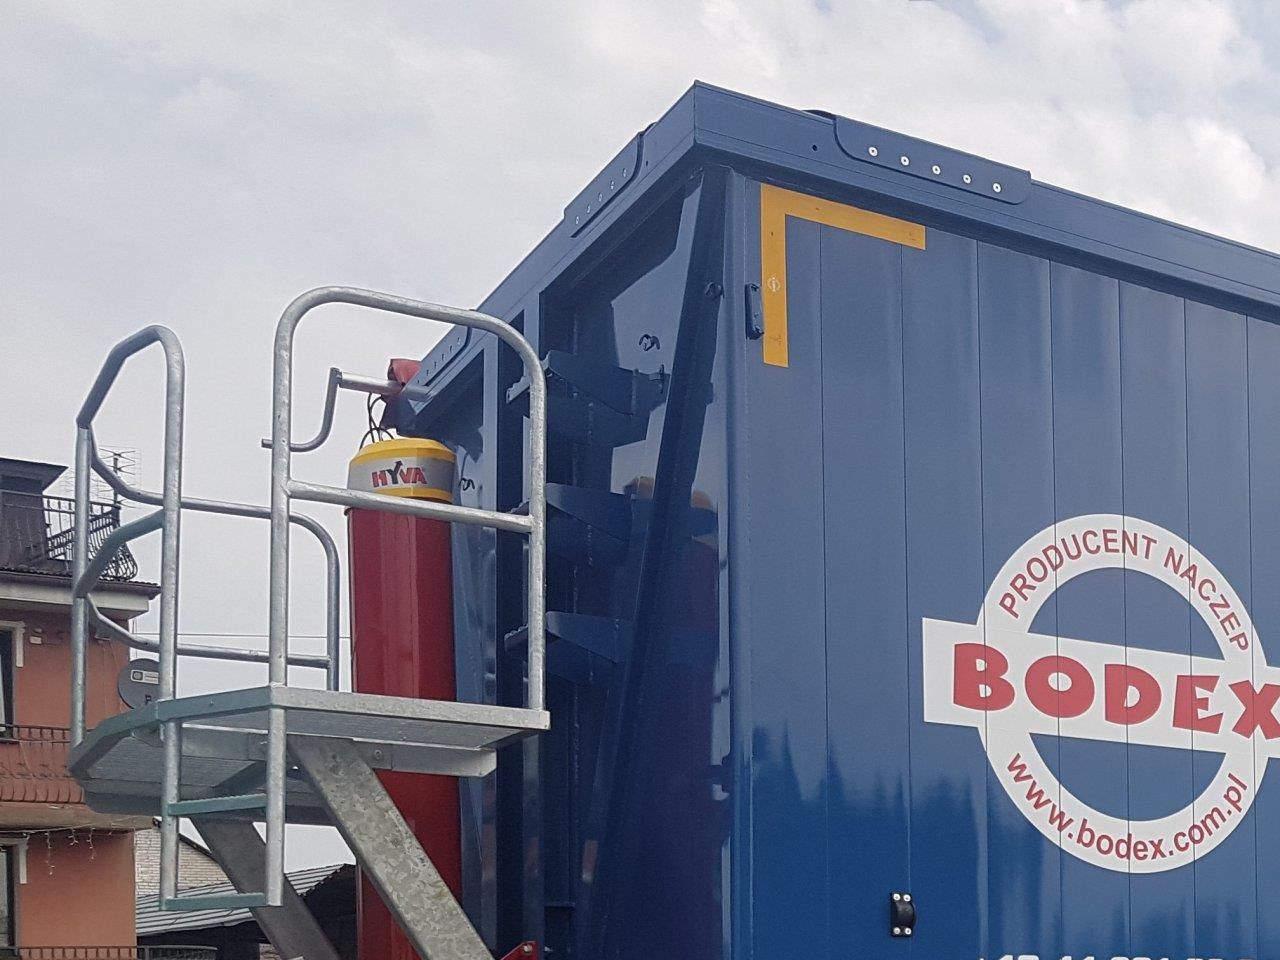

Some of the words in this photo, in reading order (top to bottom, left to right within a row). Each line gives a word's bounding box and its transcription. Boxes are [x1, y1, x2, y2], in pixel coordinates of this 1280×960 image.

[371, 461, 428, 488] HYVA
[999, 528, 1158, 619] PRODUCENT
[1163, 546, 1250, 652] NACZEP
[1007, 752, 1249, 861] www.bodex.com.pl
